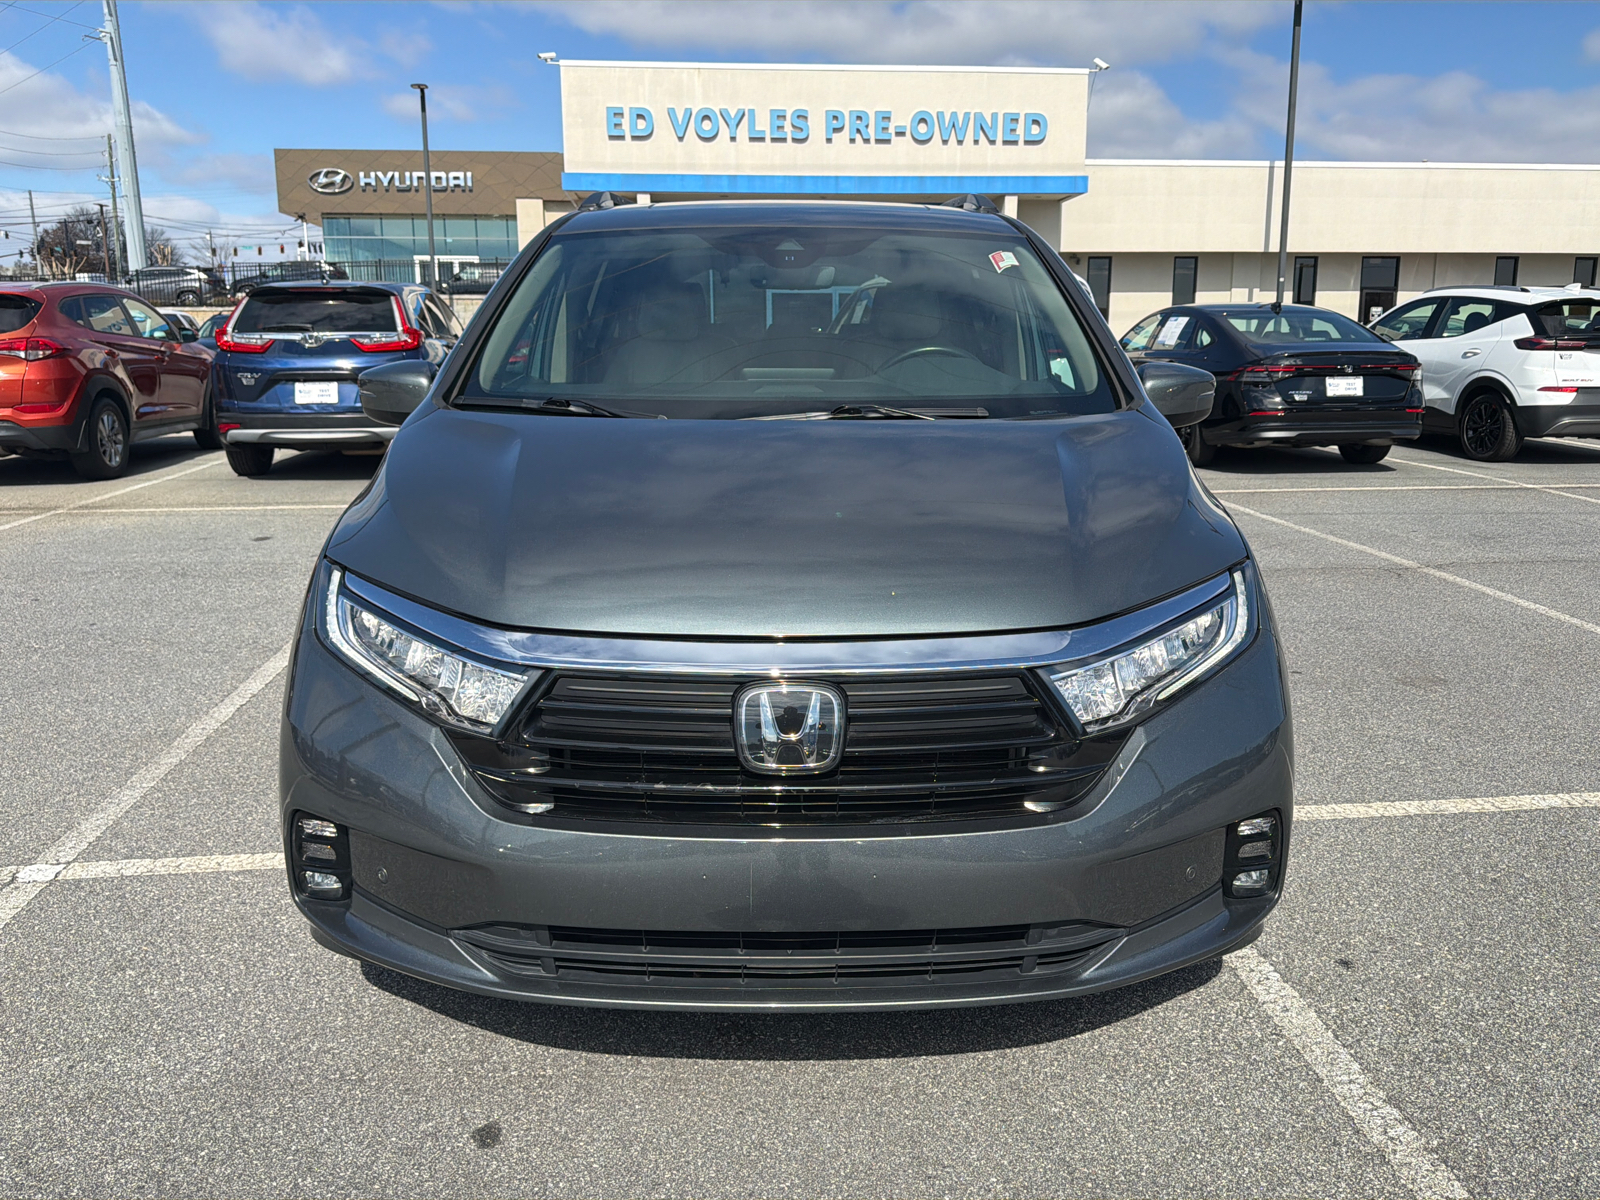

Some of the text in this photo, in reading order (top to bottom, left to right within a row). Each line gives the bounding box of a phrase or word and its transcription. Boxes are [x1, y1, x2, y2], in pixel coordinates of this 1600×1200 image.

[606, 106, 1048, 145] ED VOYLES PRE-OWNED
[358, 171, 474, 192] HYUNDAI
